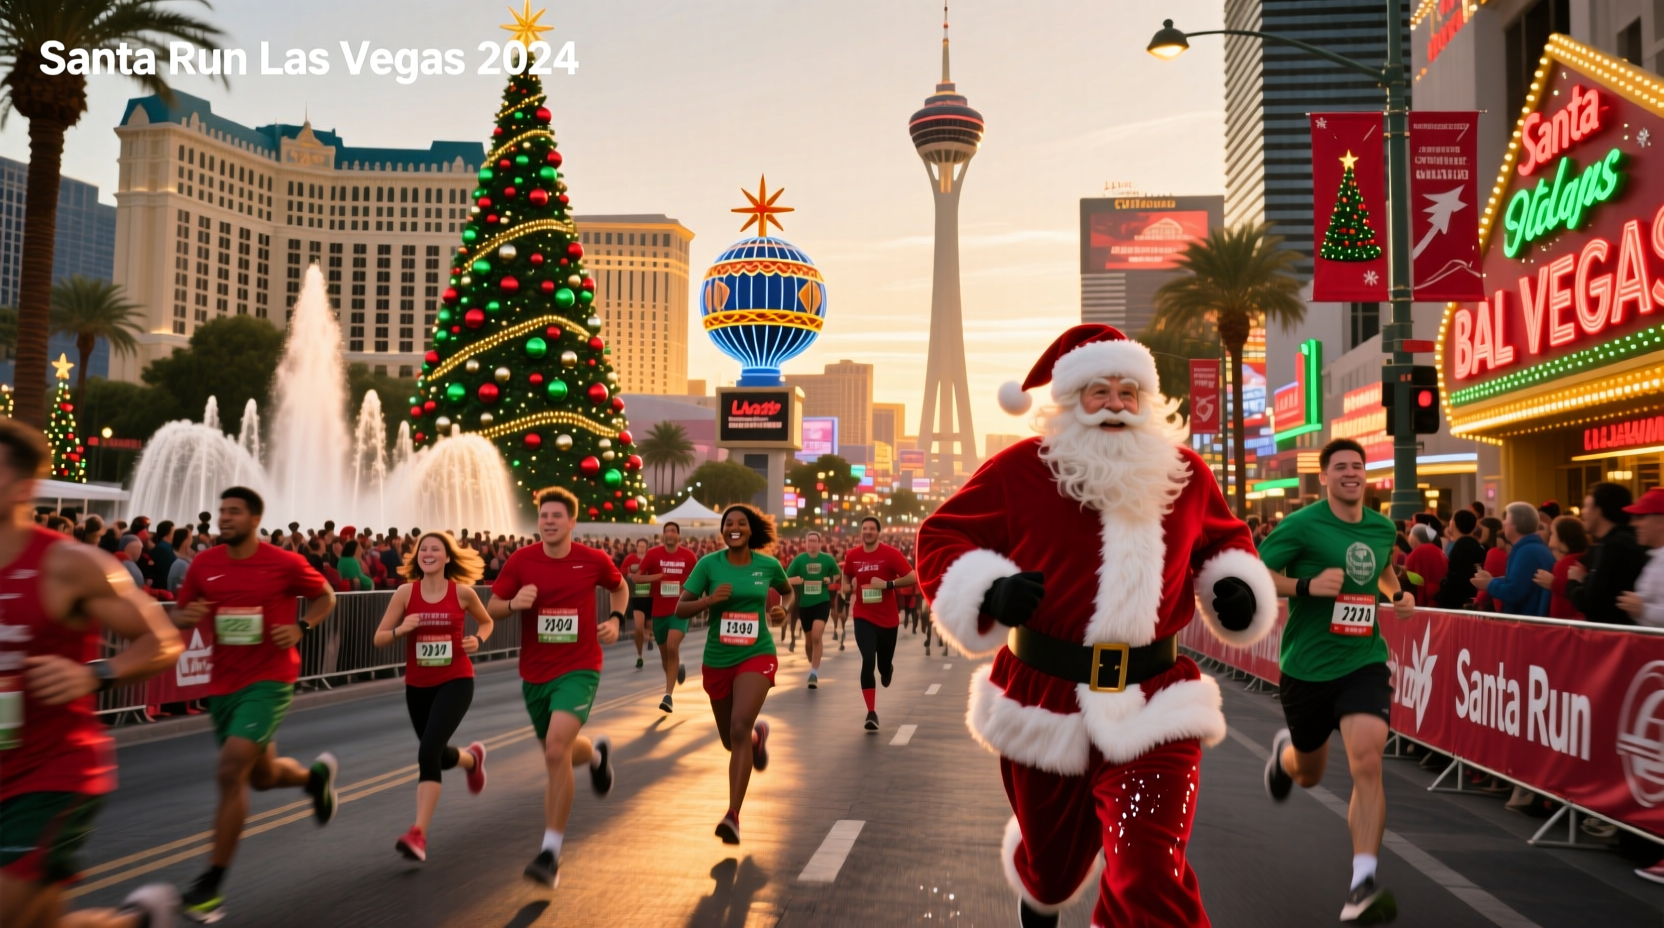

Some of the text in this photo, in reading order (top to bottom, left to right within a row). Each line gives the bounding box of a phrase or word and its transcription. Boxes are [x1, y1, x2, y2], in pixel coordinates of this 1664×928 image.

[1517, 84, 1600, 177] Santa
[1454, 290, 1514, 380] BAL
[1455, 648, 1521, 738] Santa
[1527, 664, 1592, 762] Run
